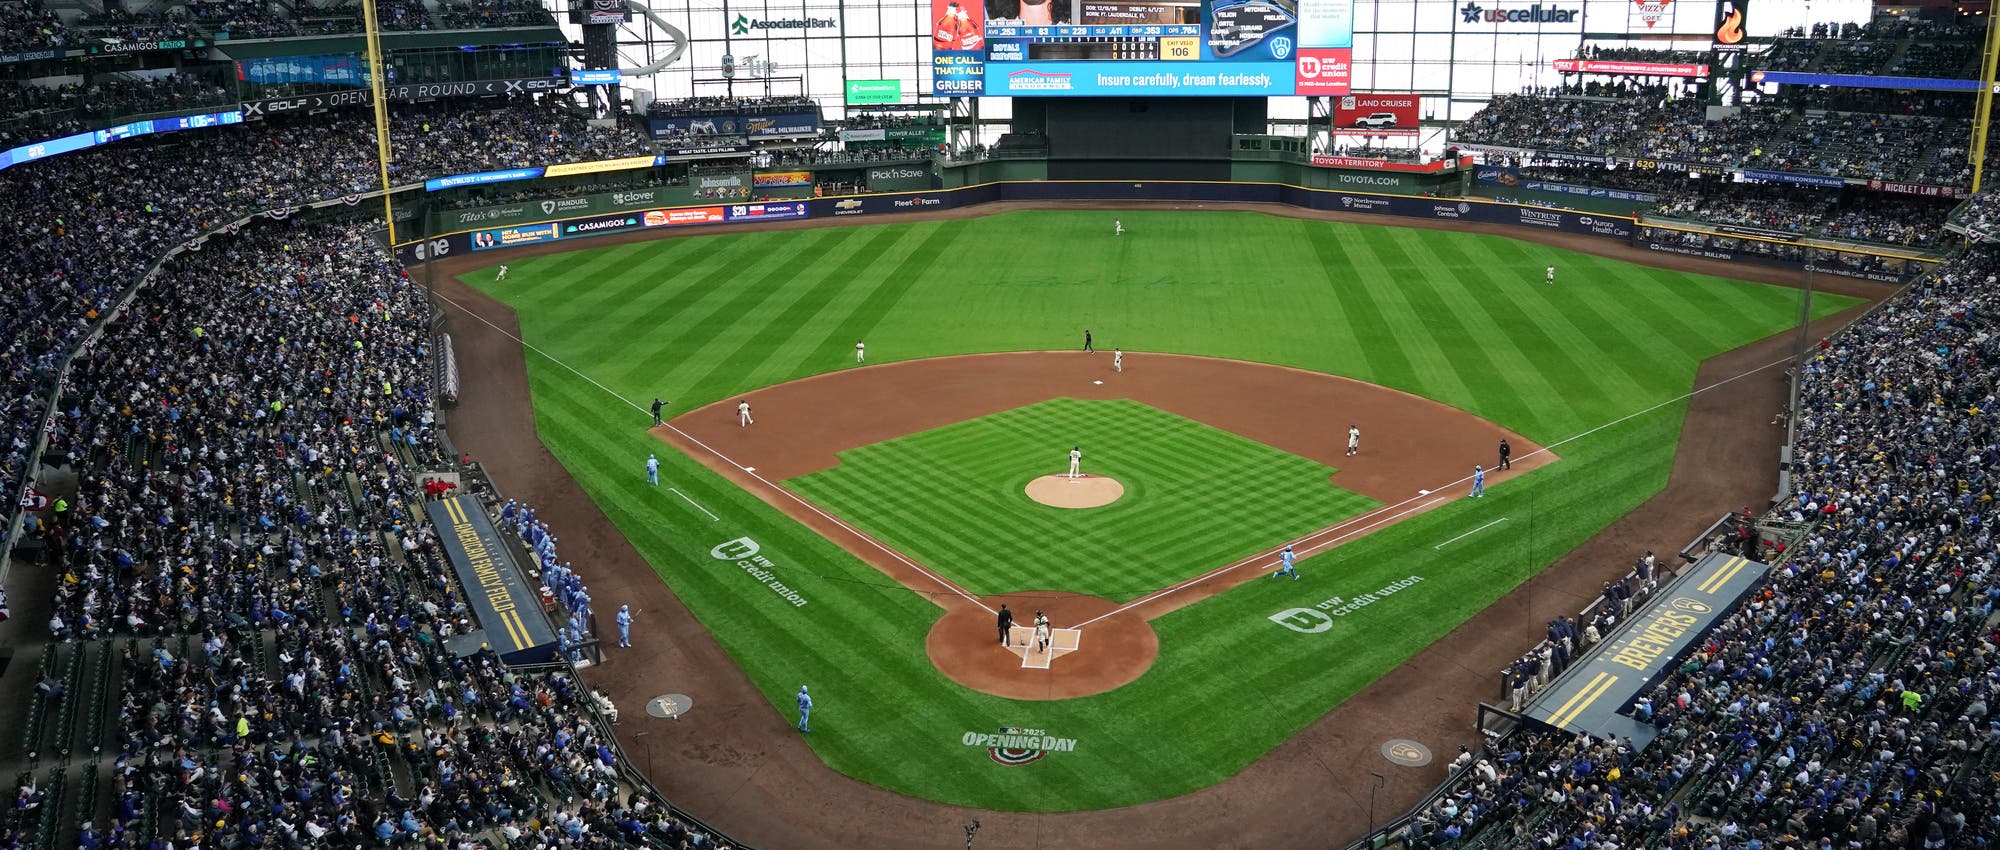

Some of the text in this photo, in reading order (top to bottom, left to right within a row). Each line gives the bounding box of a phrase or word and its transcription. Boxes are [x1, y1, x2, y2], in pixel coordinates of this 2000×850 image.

[1639, 4, 1666, 12] VIZZY
[1484, 8, 1579, 23] uscellular
[105, 42, 158, 52] CASAMIGOS
[1171, 48, 1189, 56] 106
[991, 52, 1022, 60] BREWERS
[505, 79, 566, 91] X GOLF
[936, 80, 982, 90] GRUBER
[1098, 73, 1272, 88] Insure carefully, dream fearlessly.
[419, 84, 475, 96] ROUND
[244, 92, 367, 116] X GOLF OPEN
[746, 119, 776, 134] Miller
[779, 126, 812, 134] MILWAUKEE
[1345, 159, 1384, 167] TERRITORY
[1637, 161, 1655, 169] 620
[872, 171, 889, 179] Pick
[900, 169, 923, 178] Save
[1745, 171, 1777, 180] WINTRUST
[440, 177, 475, 187] WINTRUST
[700, 176, 741, 188] Johnsonville
[1339, 175, 1399, 186] TOYOTA.COM
[1569, 187, 1589, 195] DELICIOUS
[1885, 184, 1938, 195] NICOLET LAW
[558, 198, 588, 206] FANDUEL
[624, 192, 654, 201] clover
[732, 206, 746, 217] $20
[1520, 209, 1560, 220] WINTRUST
[460, 212, 486, 223] Tito's
[579, 219, 625, 231] CASAMIGOS
[1592, 225, 1629, 236] Health Care
[1704, 252, 1731, 260] BULLPEN
[1868, 274, 1899, 282] BULLPEN
[752, 555, 775, 567] uw
[454, 523, 515, 612] AMERICAN FAMILY FIELD
[737, 560, 807, 607] credit union
[1333, 574, 1424, 616] credit union
[1316, 596, 1344, 610] uw
[1611, 610, 1697, 670] BREWERS
[962, 731, 1077, 751] OPENING DAY
